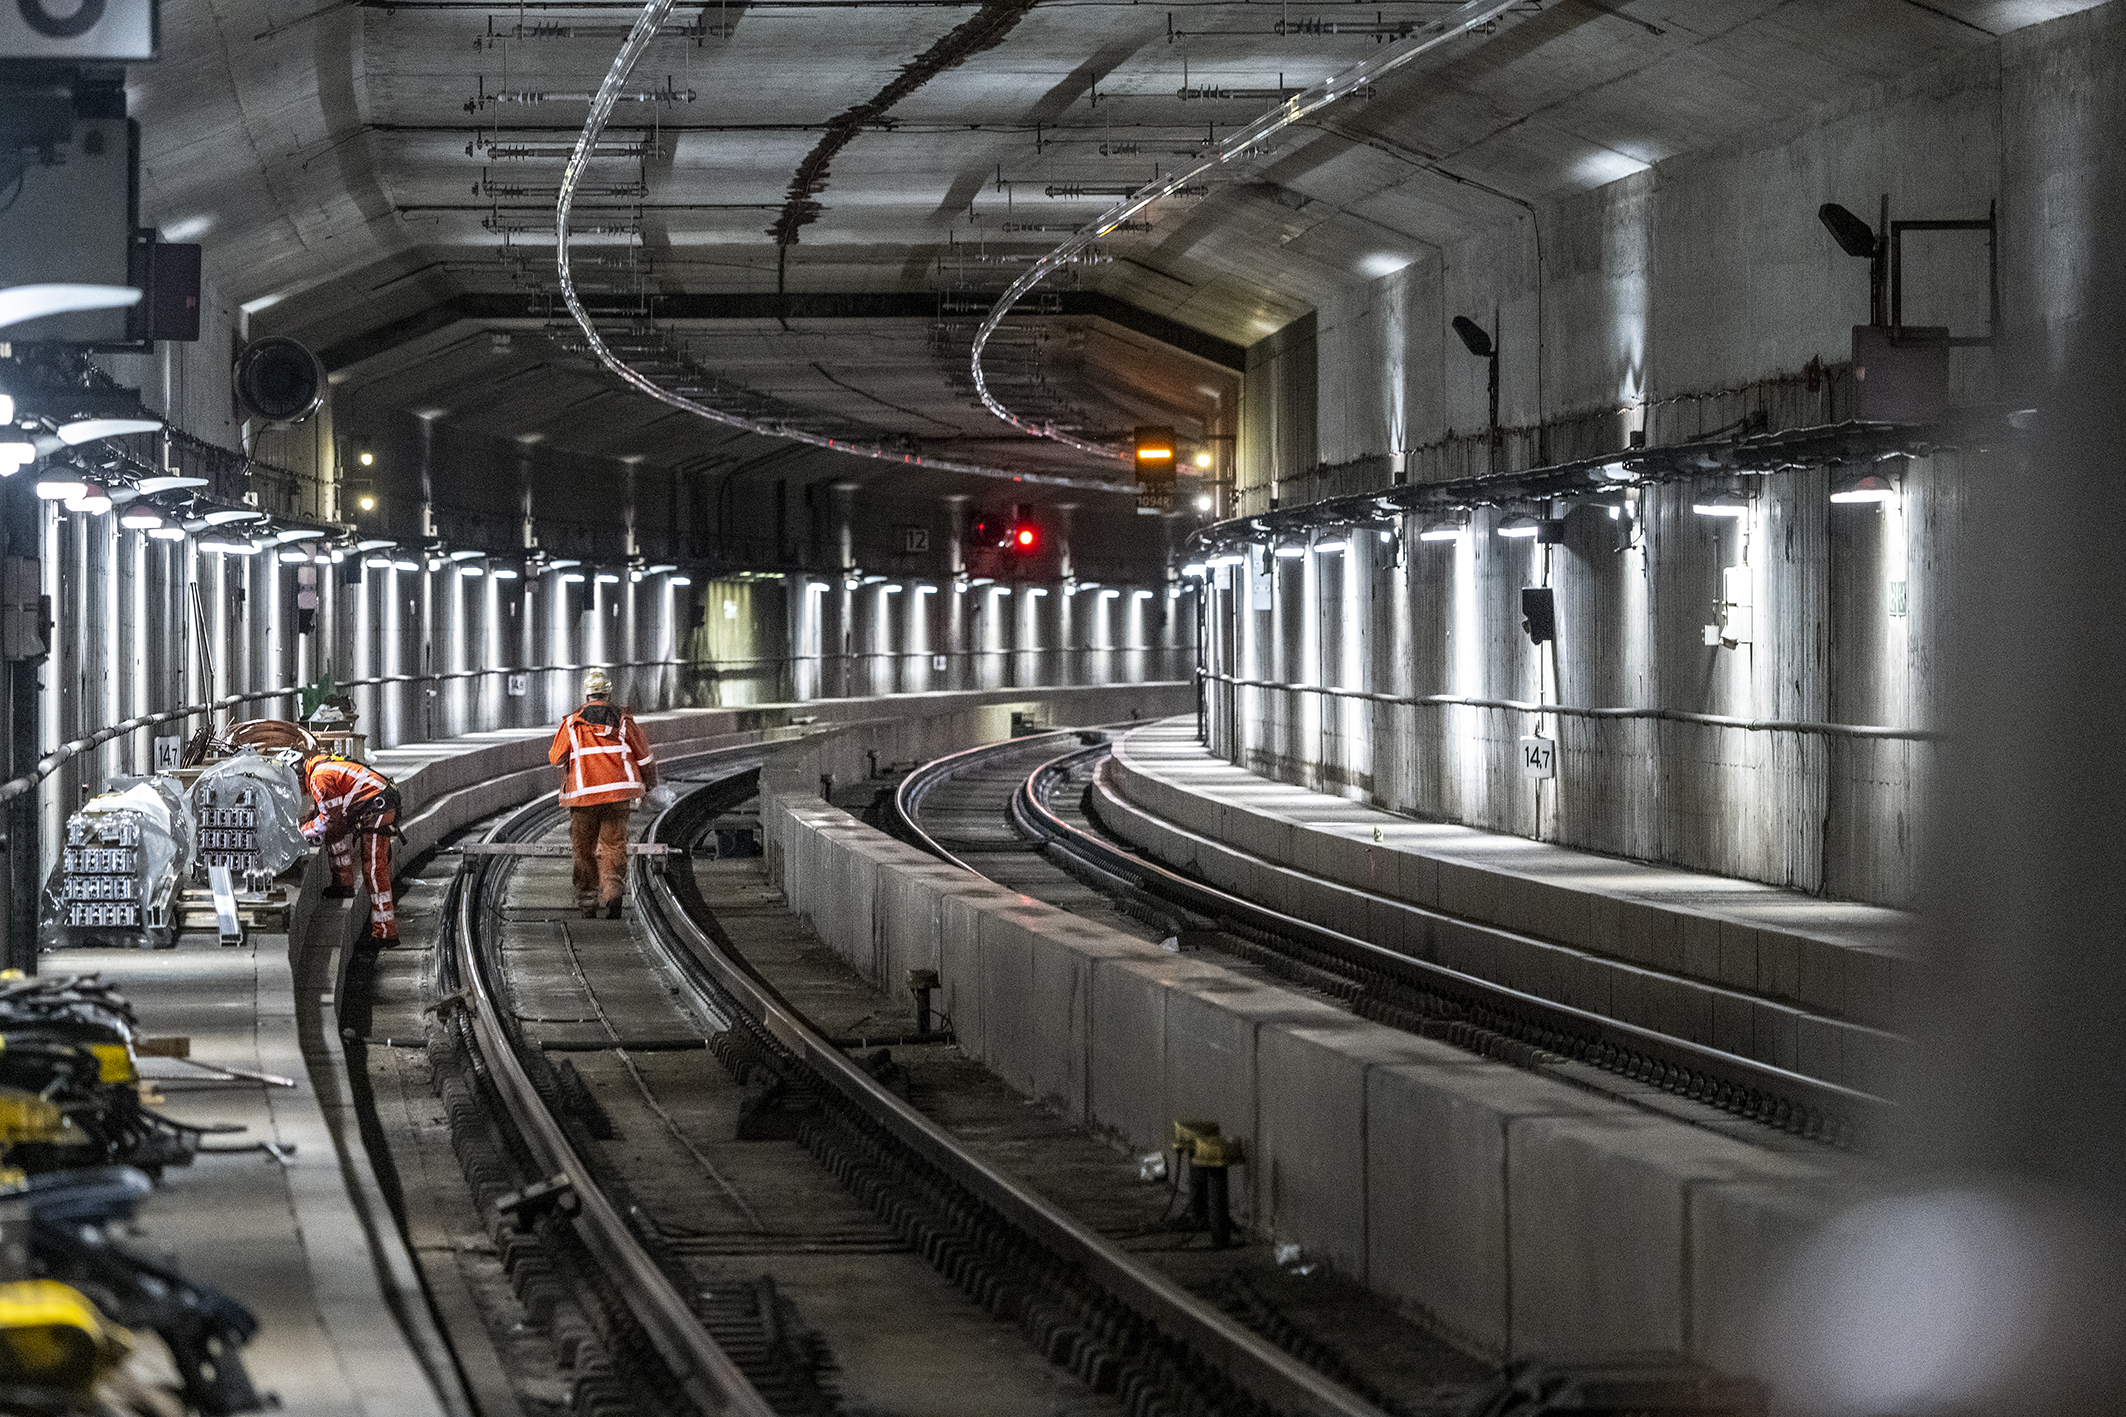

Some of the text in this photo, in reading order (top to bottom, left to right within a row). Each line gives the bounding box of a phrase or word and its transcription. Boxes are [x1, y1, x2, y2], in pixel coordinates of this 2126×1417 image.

[908, 531, 926, 549] 12
[159, 744, 178, 768] 14,7
[1525, 746, 1550, 769] 14,7
